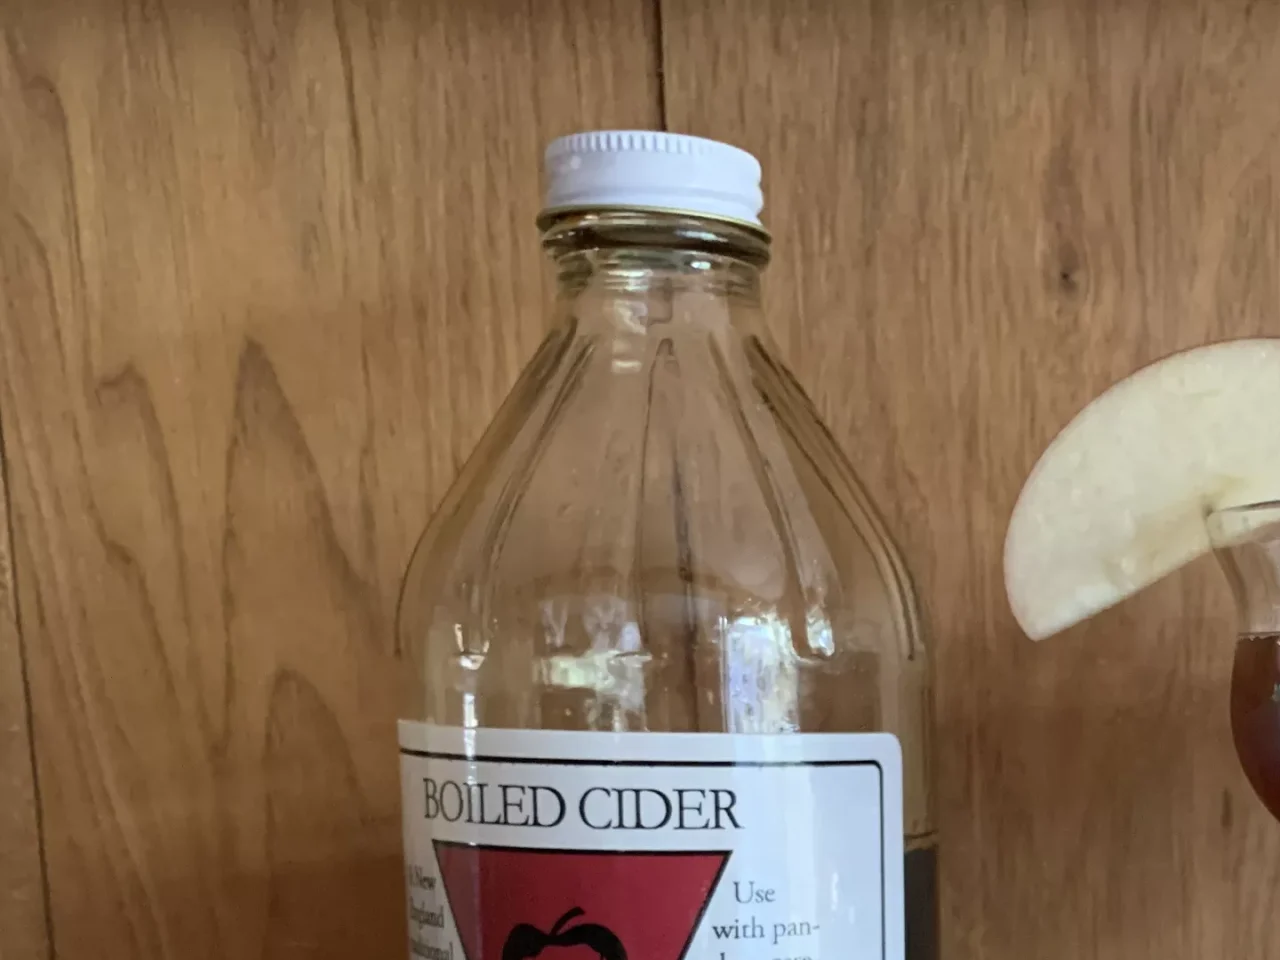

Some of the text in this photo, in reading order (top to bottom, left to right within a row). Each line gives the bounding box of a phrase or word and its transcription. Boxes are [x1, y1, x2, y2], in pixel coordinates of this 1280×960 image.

[423, 778, 743, 829] BOILED CIDER
[733, 881, 776, 904] Use
[713, 916, 820, 945] with pan-
